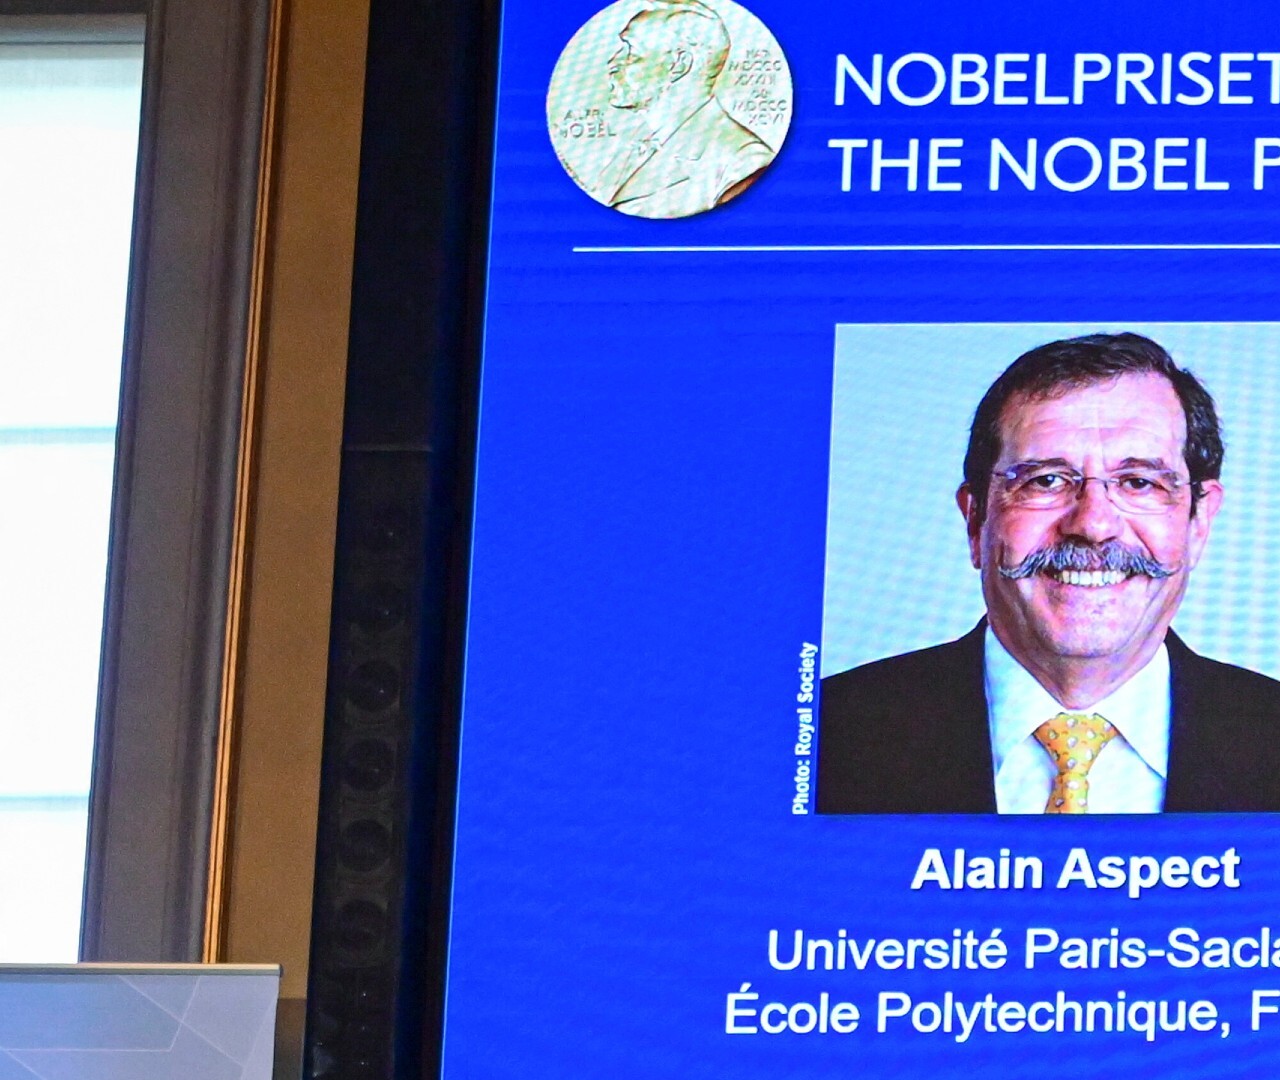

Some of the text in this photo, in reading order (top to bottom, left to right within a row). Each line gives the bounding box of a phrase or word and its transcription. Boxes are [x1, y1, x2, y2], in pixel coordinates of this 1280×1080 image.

[828, 138, 964, 192] THE
[989, 137, 1230, 192] NOBEL
[792, 641, 819, 815] Photo: Royal Society
[910, 847, 1241, 899] Alain Aspect
[768, 928, 1008, 971] Université
[725, 982, 860, 1034] École
[877, 990, 1230, 1043] Polytechnique,
